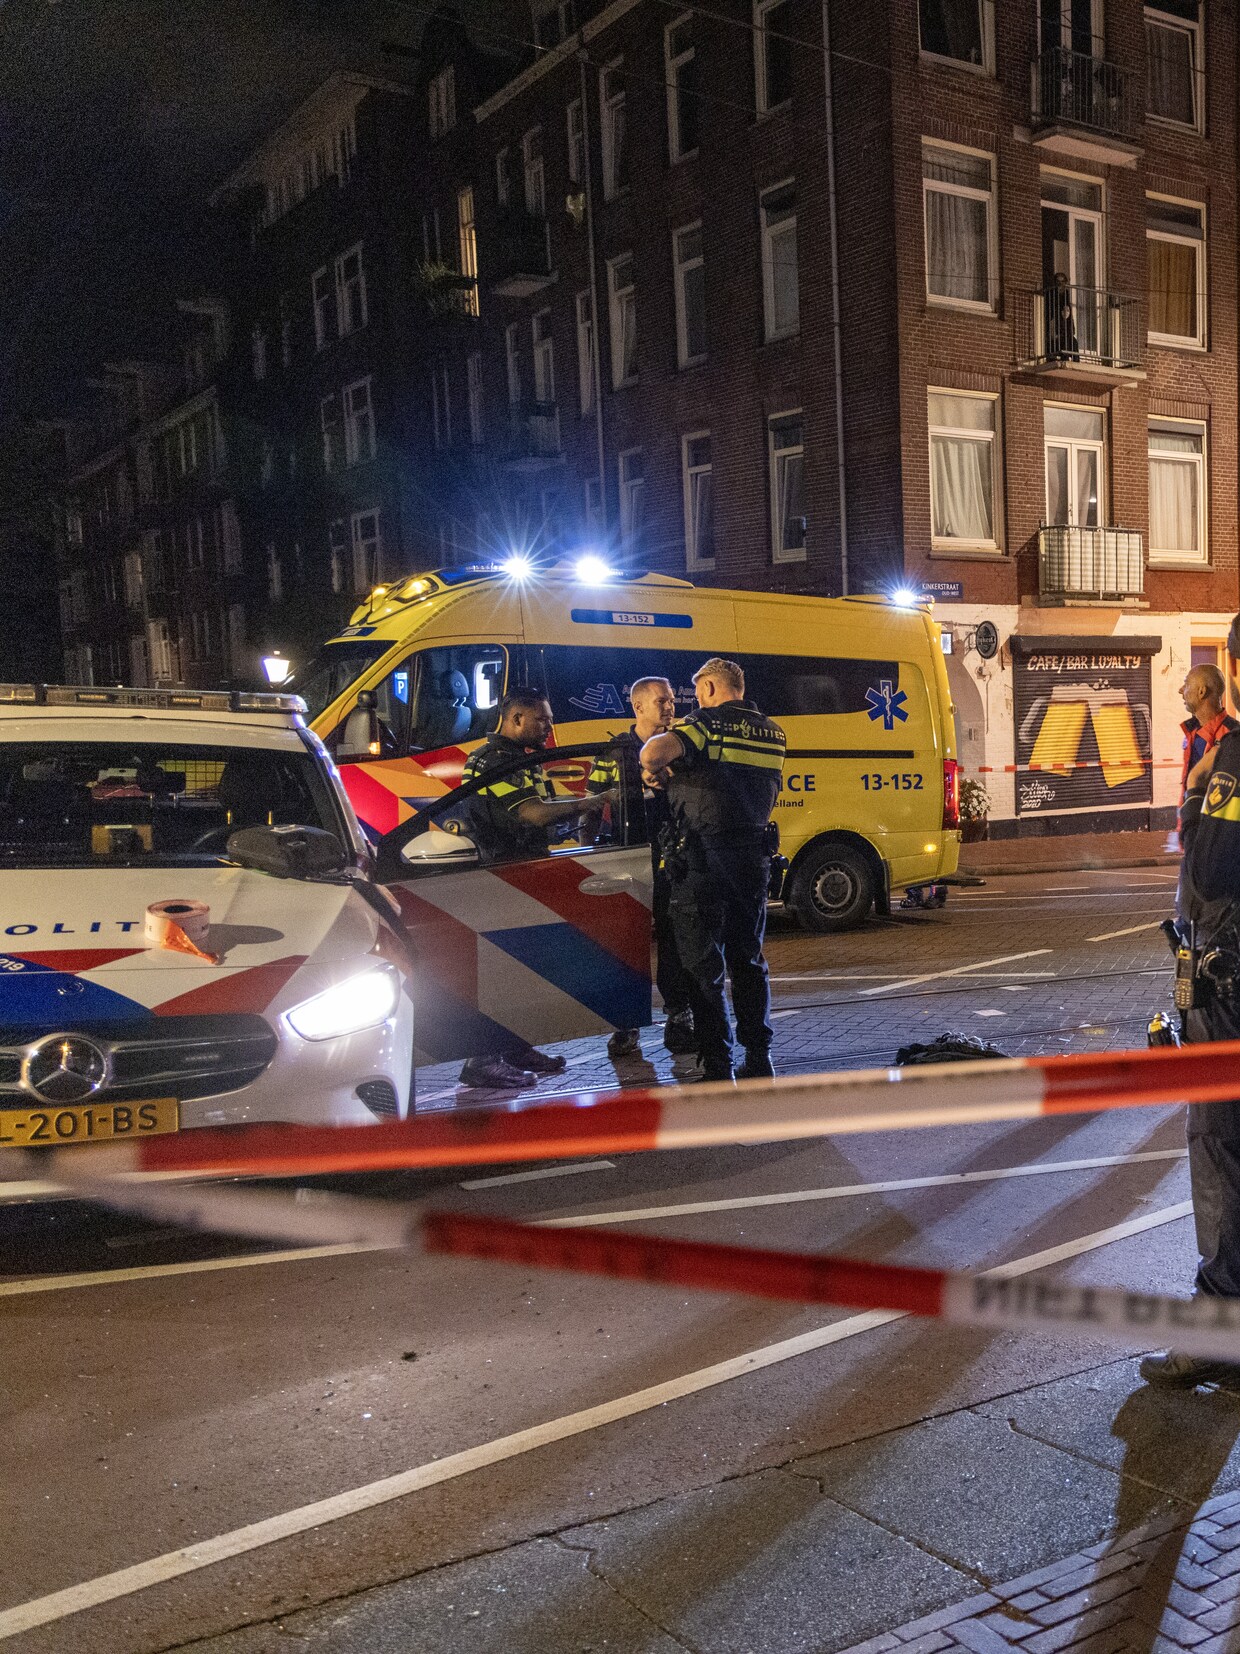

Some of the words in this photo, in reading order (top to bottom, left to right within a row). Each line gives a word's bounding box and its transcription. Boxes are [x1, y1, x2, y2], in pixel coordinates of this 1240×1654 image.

[921, 583, 960, 591] KINKERSTRAAT
[618, 614, 650, 624] 13-152
[1090, 655, 1141, 670] LOYALTY
[397, 680, 405, 694] P
[860, 773, 924, 791] 13-152
[5, 921, 140, 935] OLIT
